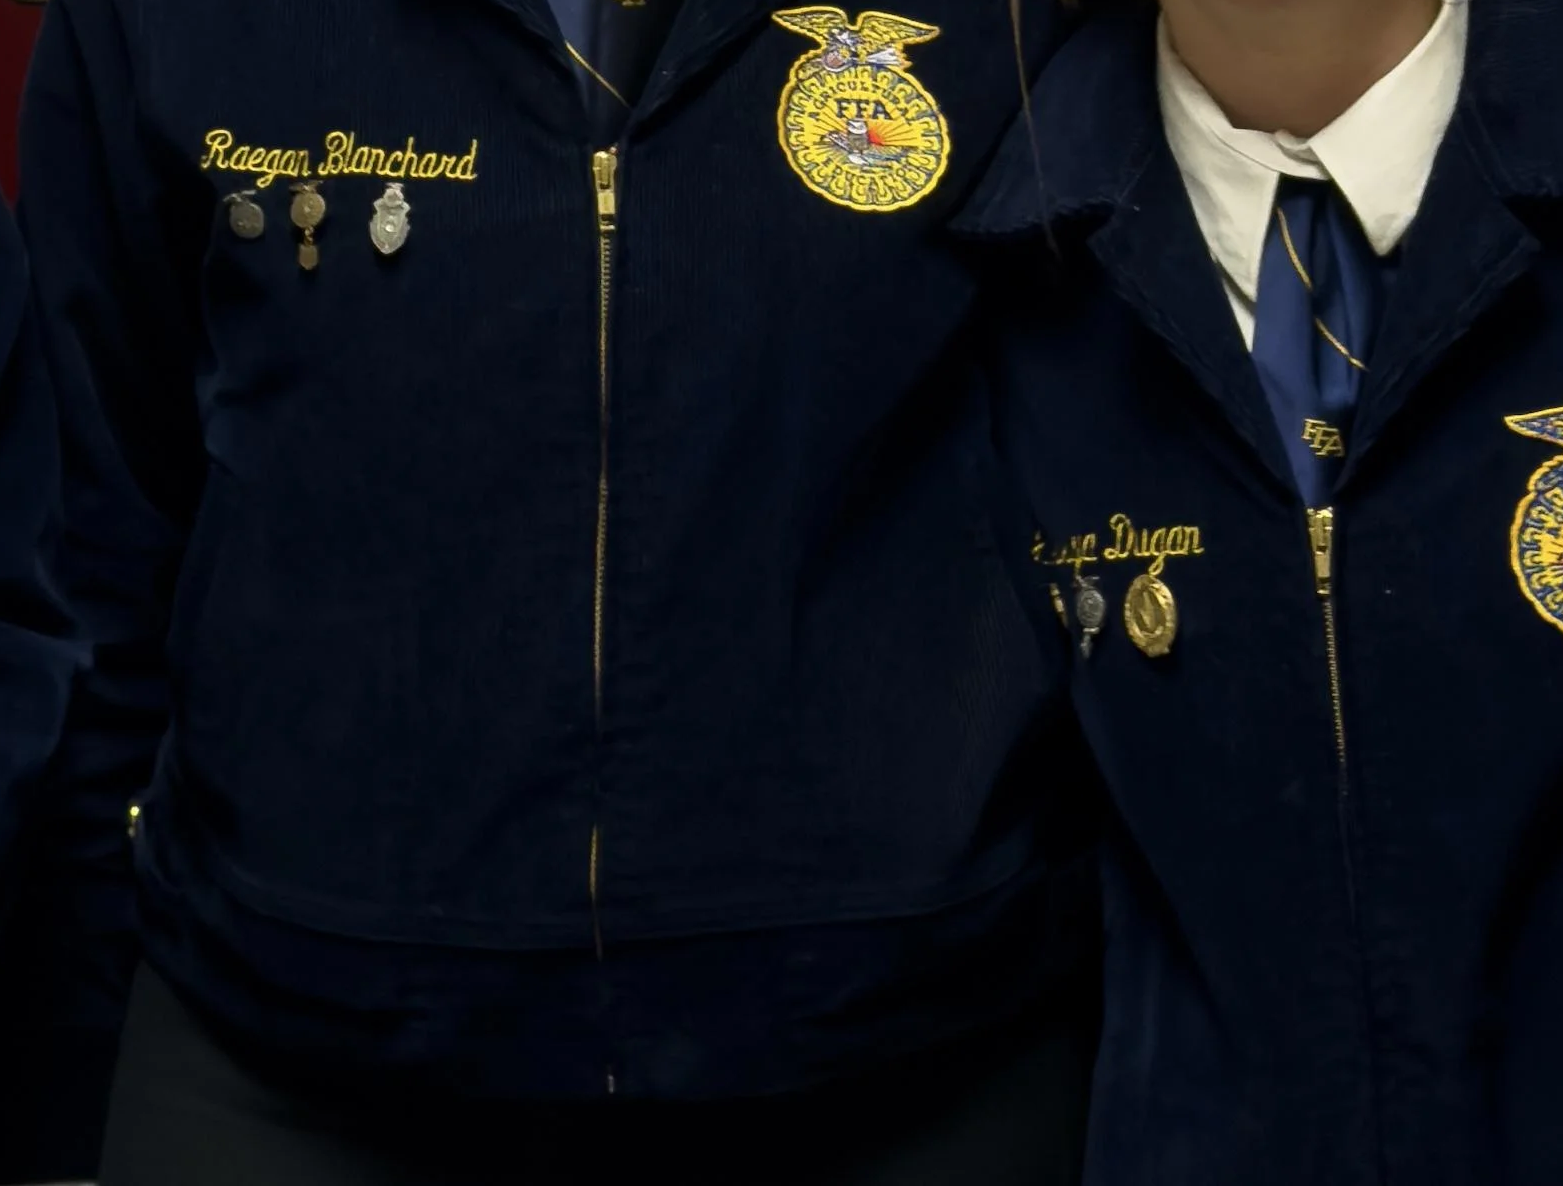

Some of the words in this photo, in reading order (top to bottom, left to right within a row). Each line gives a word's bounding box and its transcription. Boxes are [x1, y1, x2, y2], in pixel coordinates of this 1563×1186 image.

[836, 99, 894, 120] FFA
[200, 129, 311, 189] Raegan
[318, 131, 478, 181] Blanchard
[1301, 418, 1346, 457] FFA
[1103, 513, 1205, 576] Dugan
